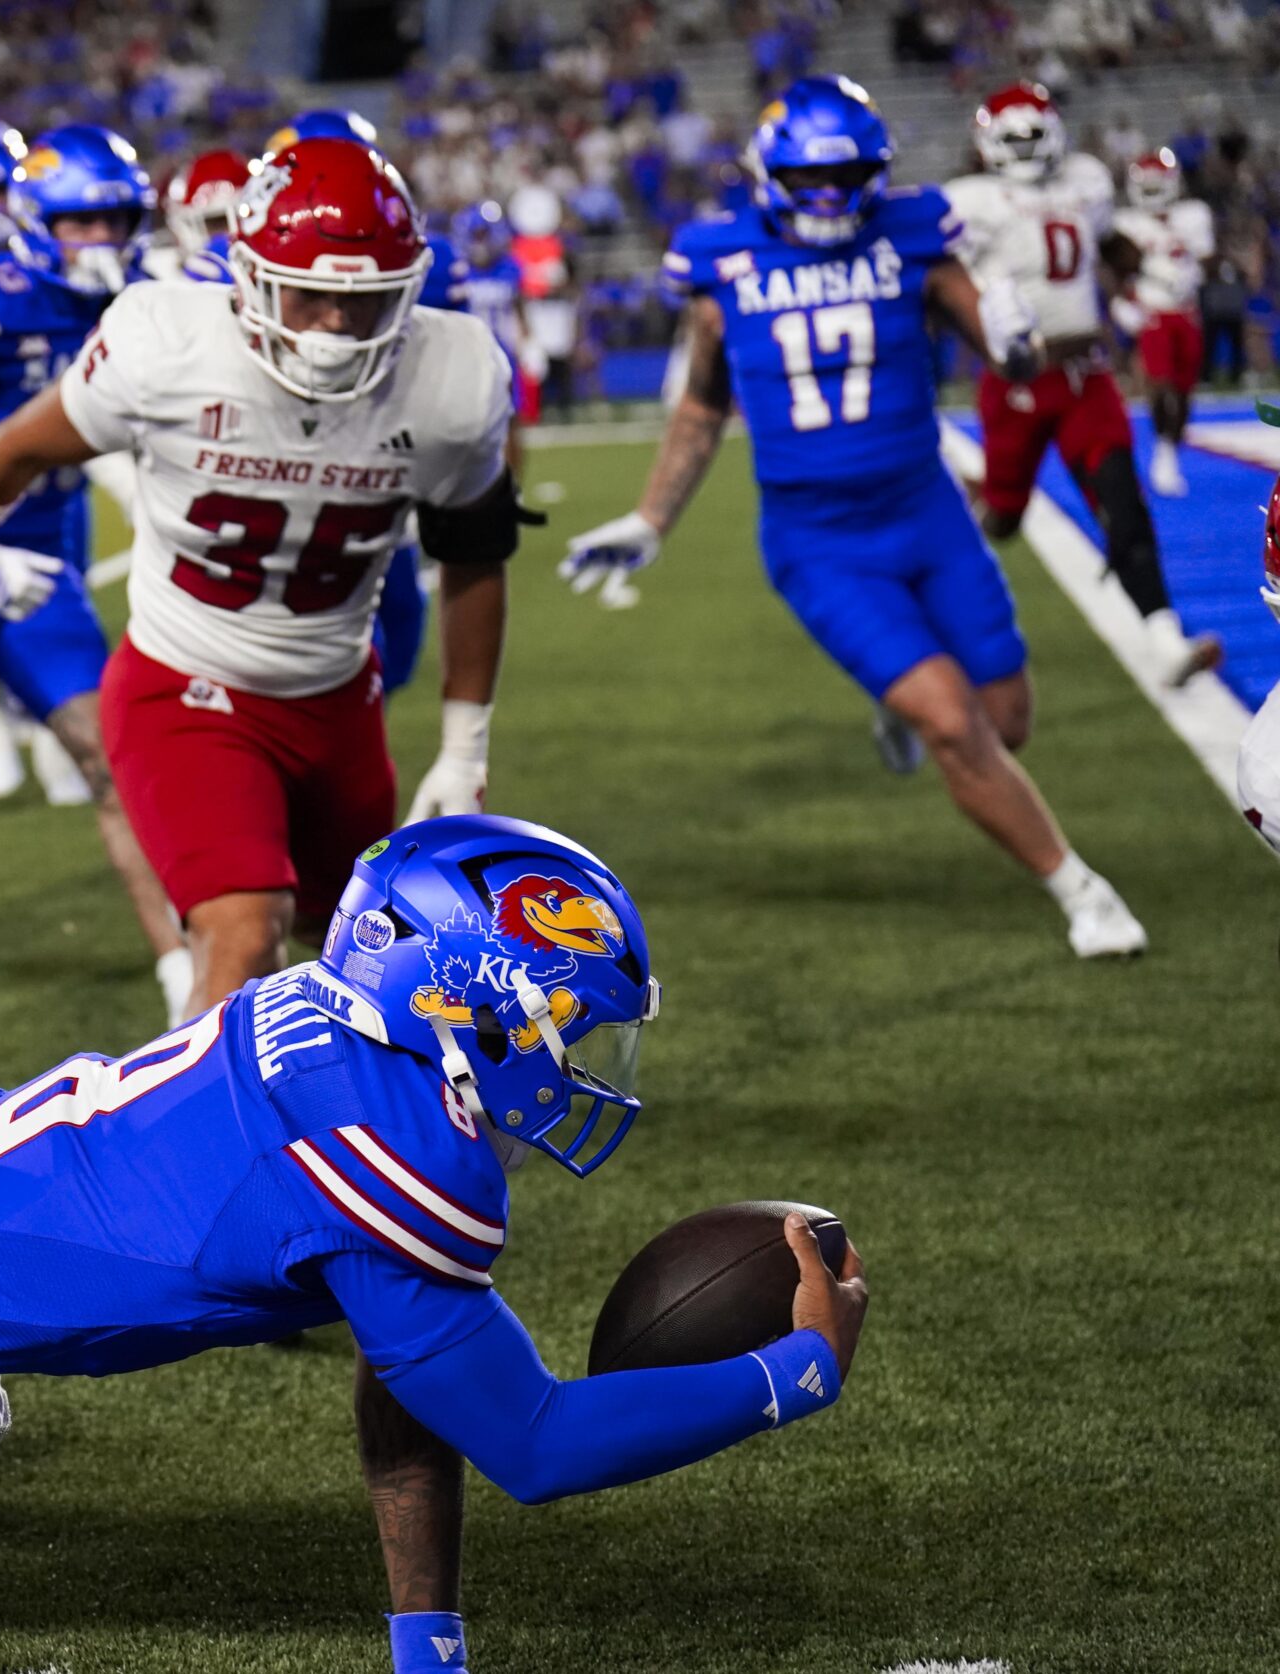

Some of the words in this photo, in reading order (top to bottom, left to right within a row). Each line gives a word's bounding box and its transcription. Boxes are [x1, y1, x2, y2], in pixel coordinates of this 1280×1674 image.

[733, 236, 904, 316] KANSAS
[771, 302, 877, 432] 17
[194, 448, 314, 485] FRESNO
[320, 463, 410, 490] STATE
[170, 490, 410, 615] 36
[473, 951, 531, 994] KU
